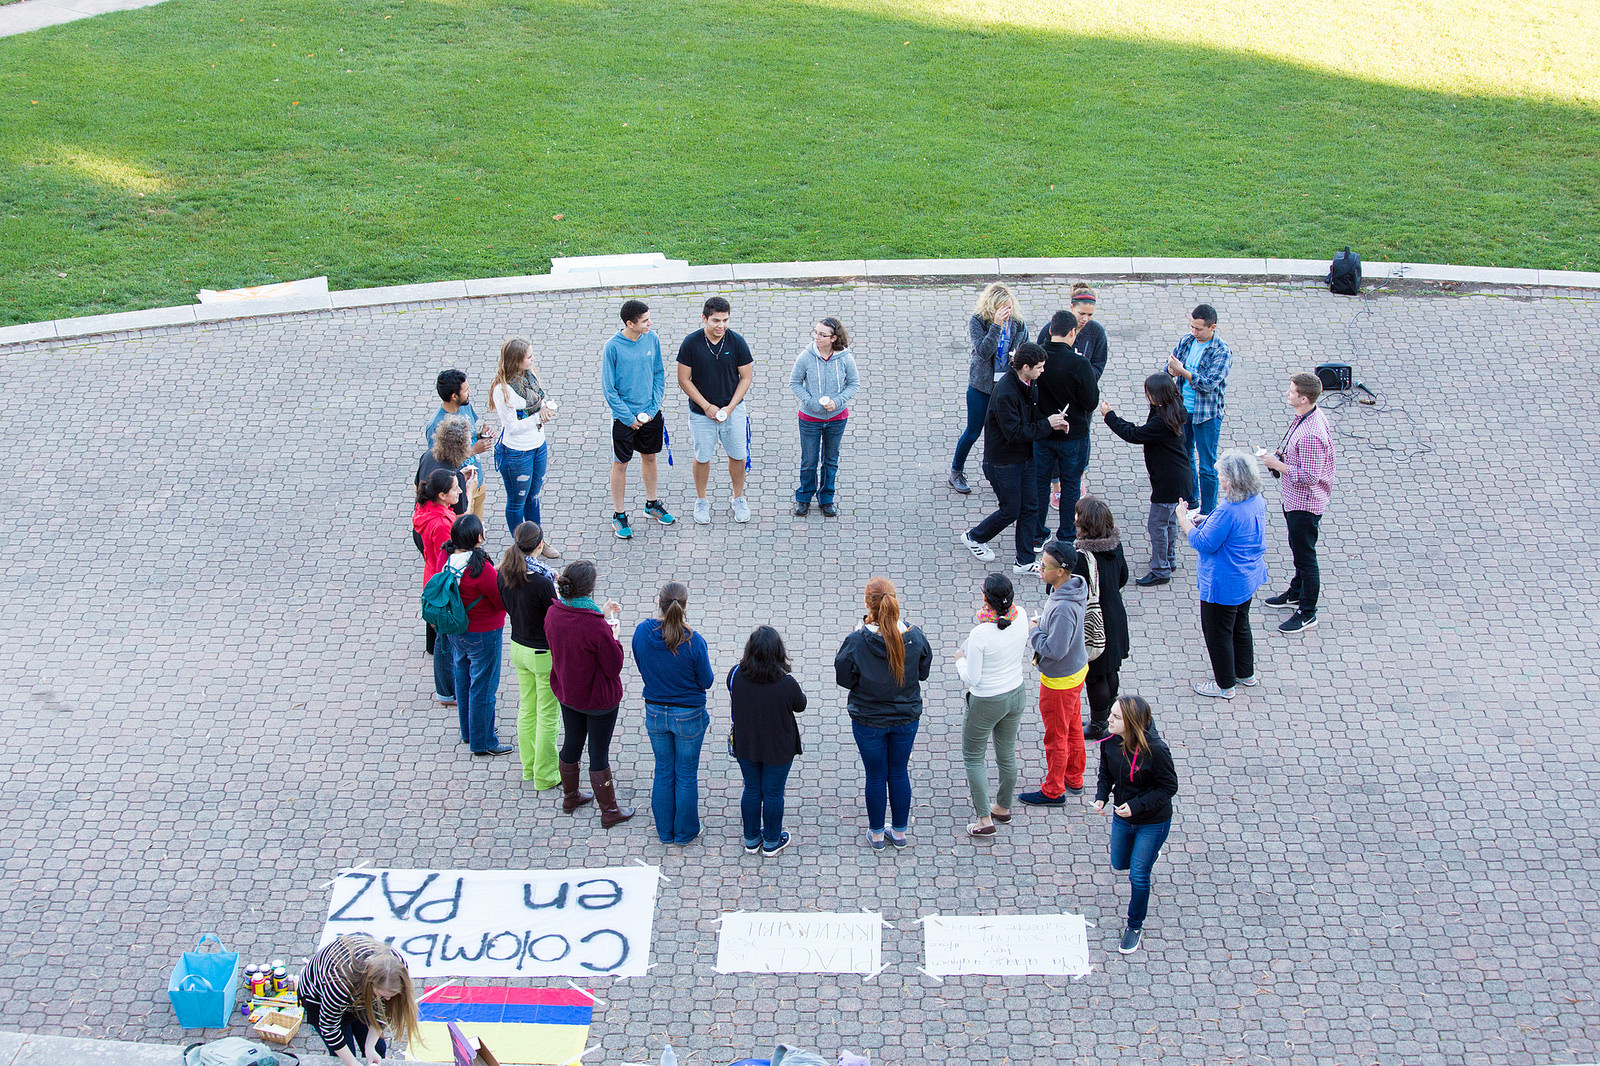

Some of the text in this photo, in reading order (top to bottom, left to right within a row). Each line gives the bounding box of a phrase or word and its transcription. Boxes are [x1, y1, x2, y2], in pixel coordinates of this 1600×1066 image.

[328, 871, 623, 924] en PAZ
[337, 929, 630, 972] Colomb
